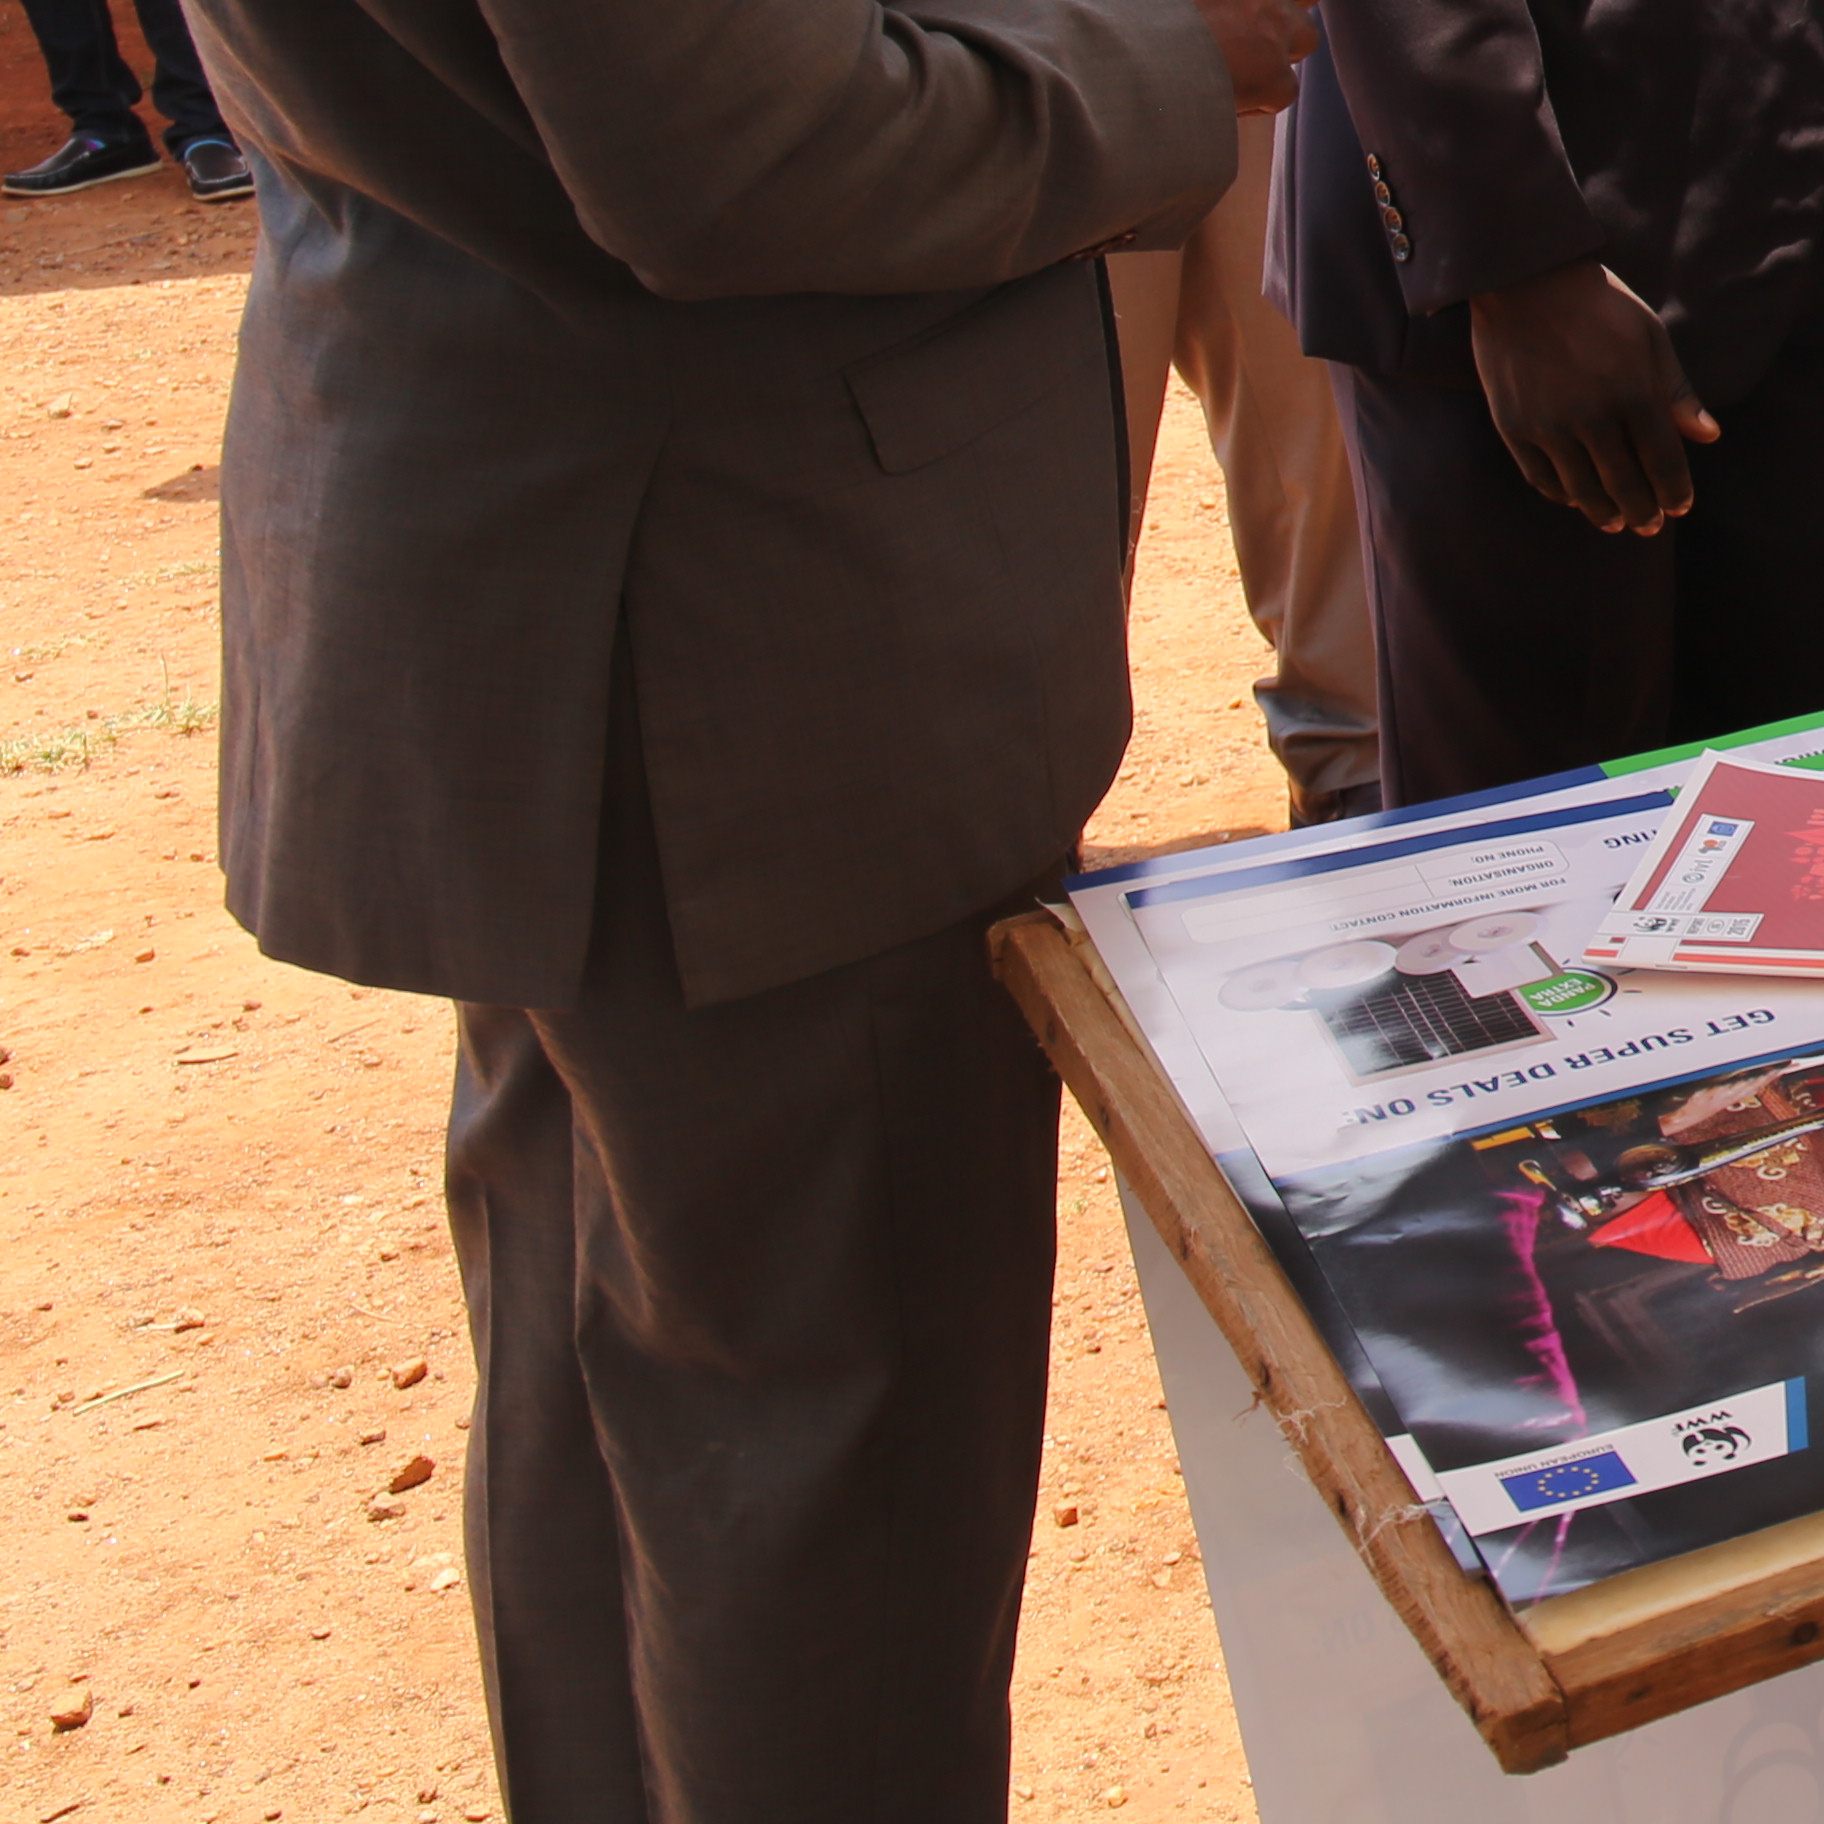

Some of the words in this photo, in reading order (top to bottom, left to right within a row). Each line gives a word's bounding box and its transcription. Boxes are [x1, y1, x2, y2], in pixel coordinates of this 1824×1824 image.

[1500, 844, 1545, 860] PHONE
[1449, 859, 1554, 889] ORGANISATION:
[1543, 877, 1567, 889] FOR
[1501, 882, 1539, 899] MORE
[1399, 891, 1495, 918] INFORMATION
[1529, 977, 1585, 1002] EXTRA
[1536, 980, 1597, 1009] PANDA
[1706, 1007, 1777, 1039] GET
[1564, 1026, 1694, 1072] SUPER
[1427, 1065, 1557, 1108] DEALS
[1342, 1098, 1416, 1126] ON:
[1542, 1444, 1614, 1467] EUROPEAN
[1494, 1462, 1538, 1479] UNION
